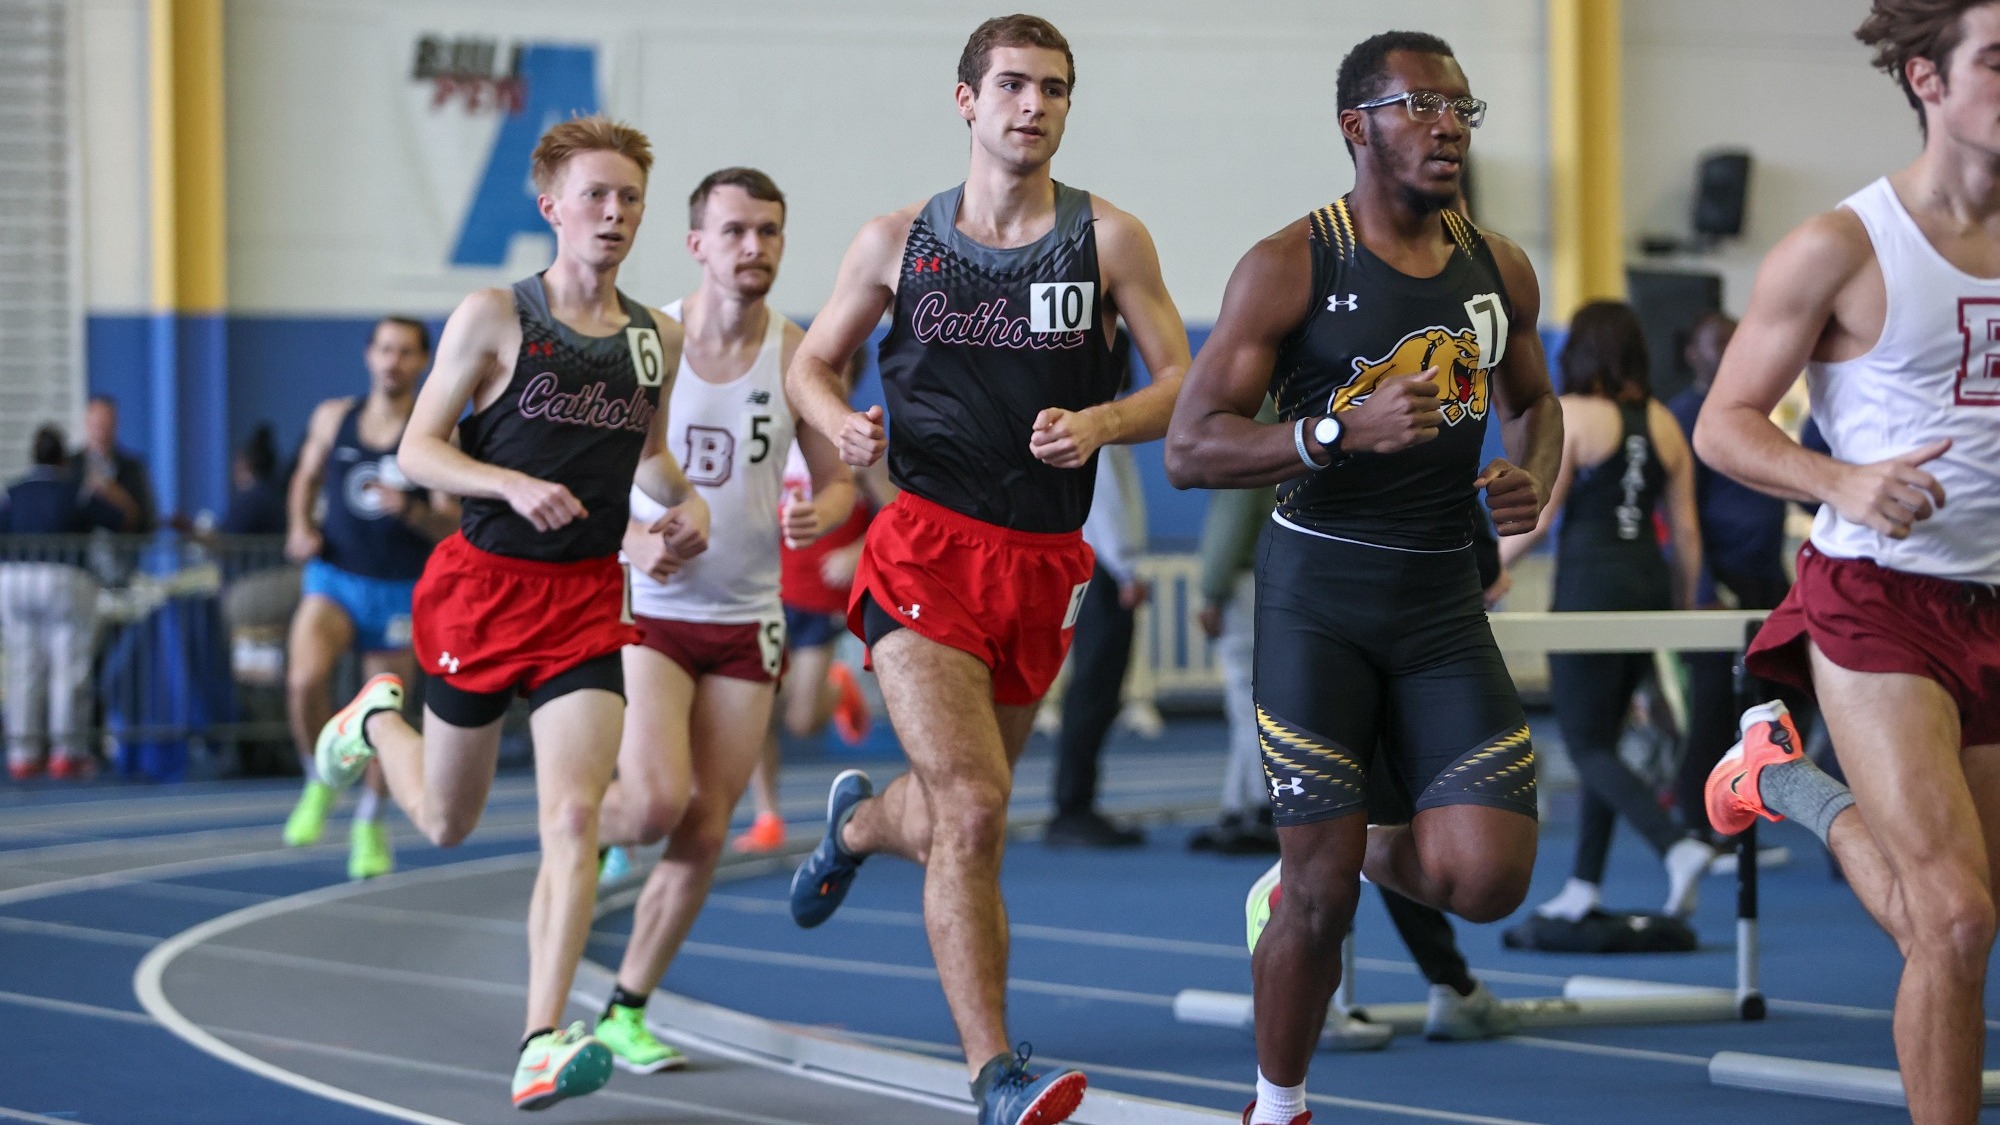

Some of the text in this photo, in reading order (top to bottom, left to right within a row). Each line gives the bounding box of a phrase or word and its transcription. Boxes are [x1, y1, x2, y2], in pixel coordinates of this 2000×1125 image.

[1041, 285, 1083, 329] 10
[1473, 299, 1498, 363] 7
[638, 331, 657, 382] 6
[684, 425, 735, 487] B
[750, 416, 770, 463] 5
